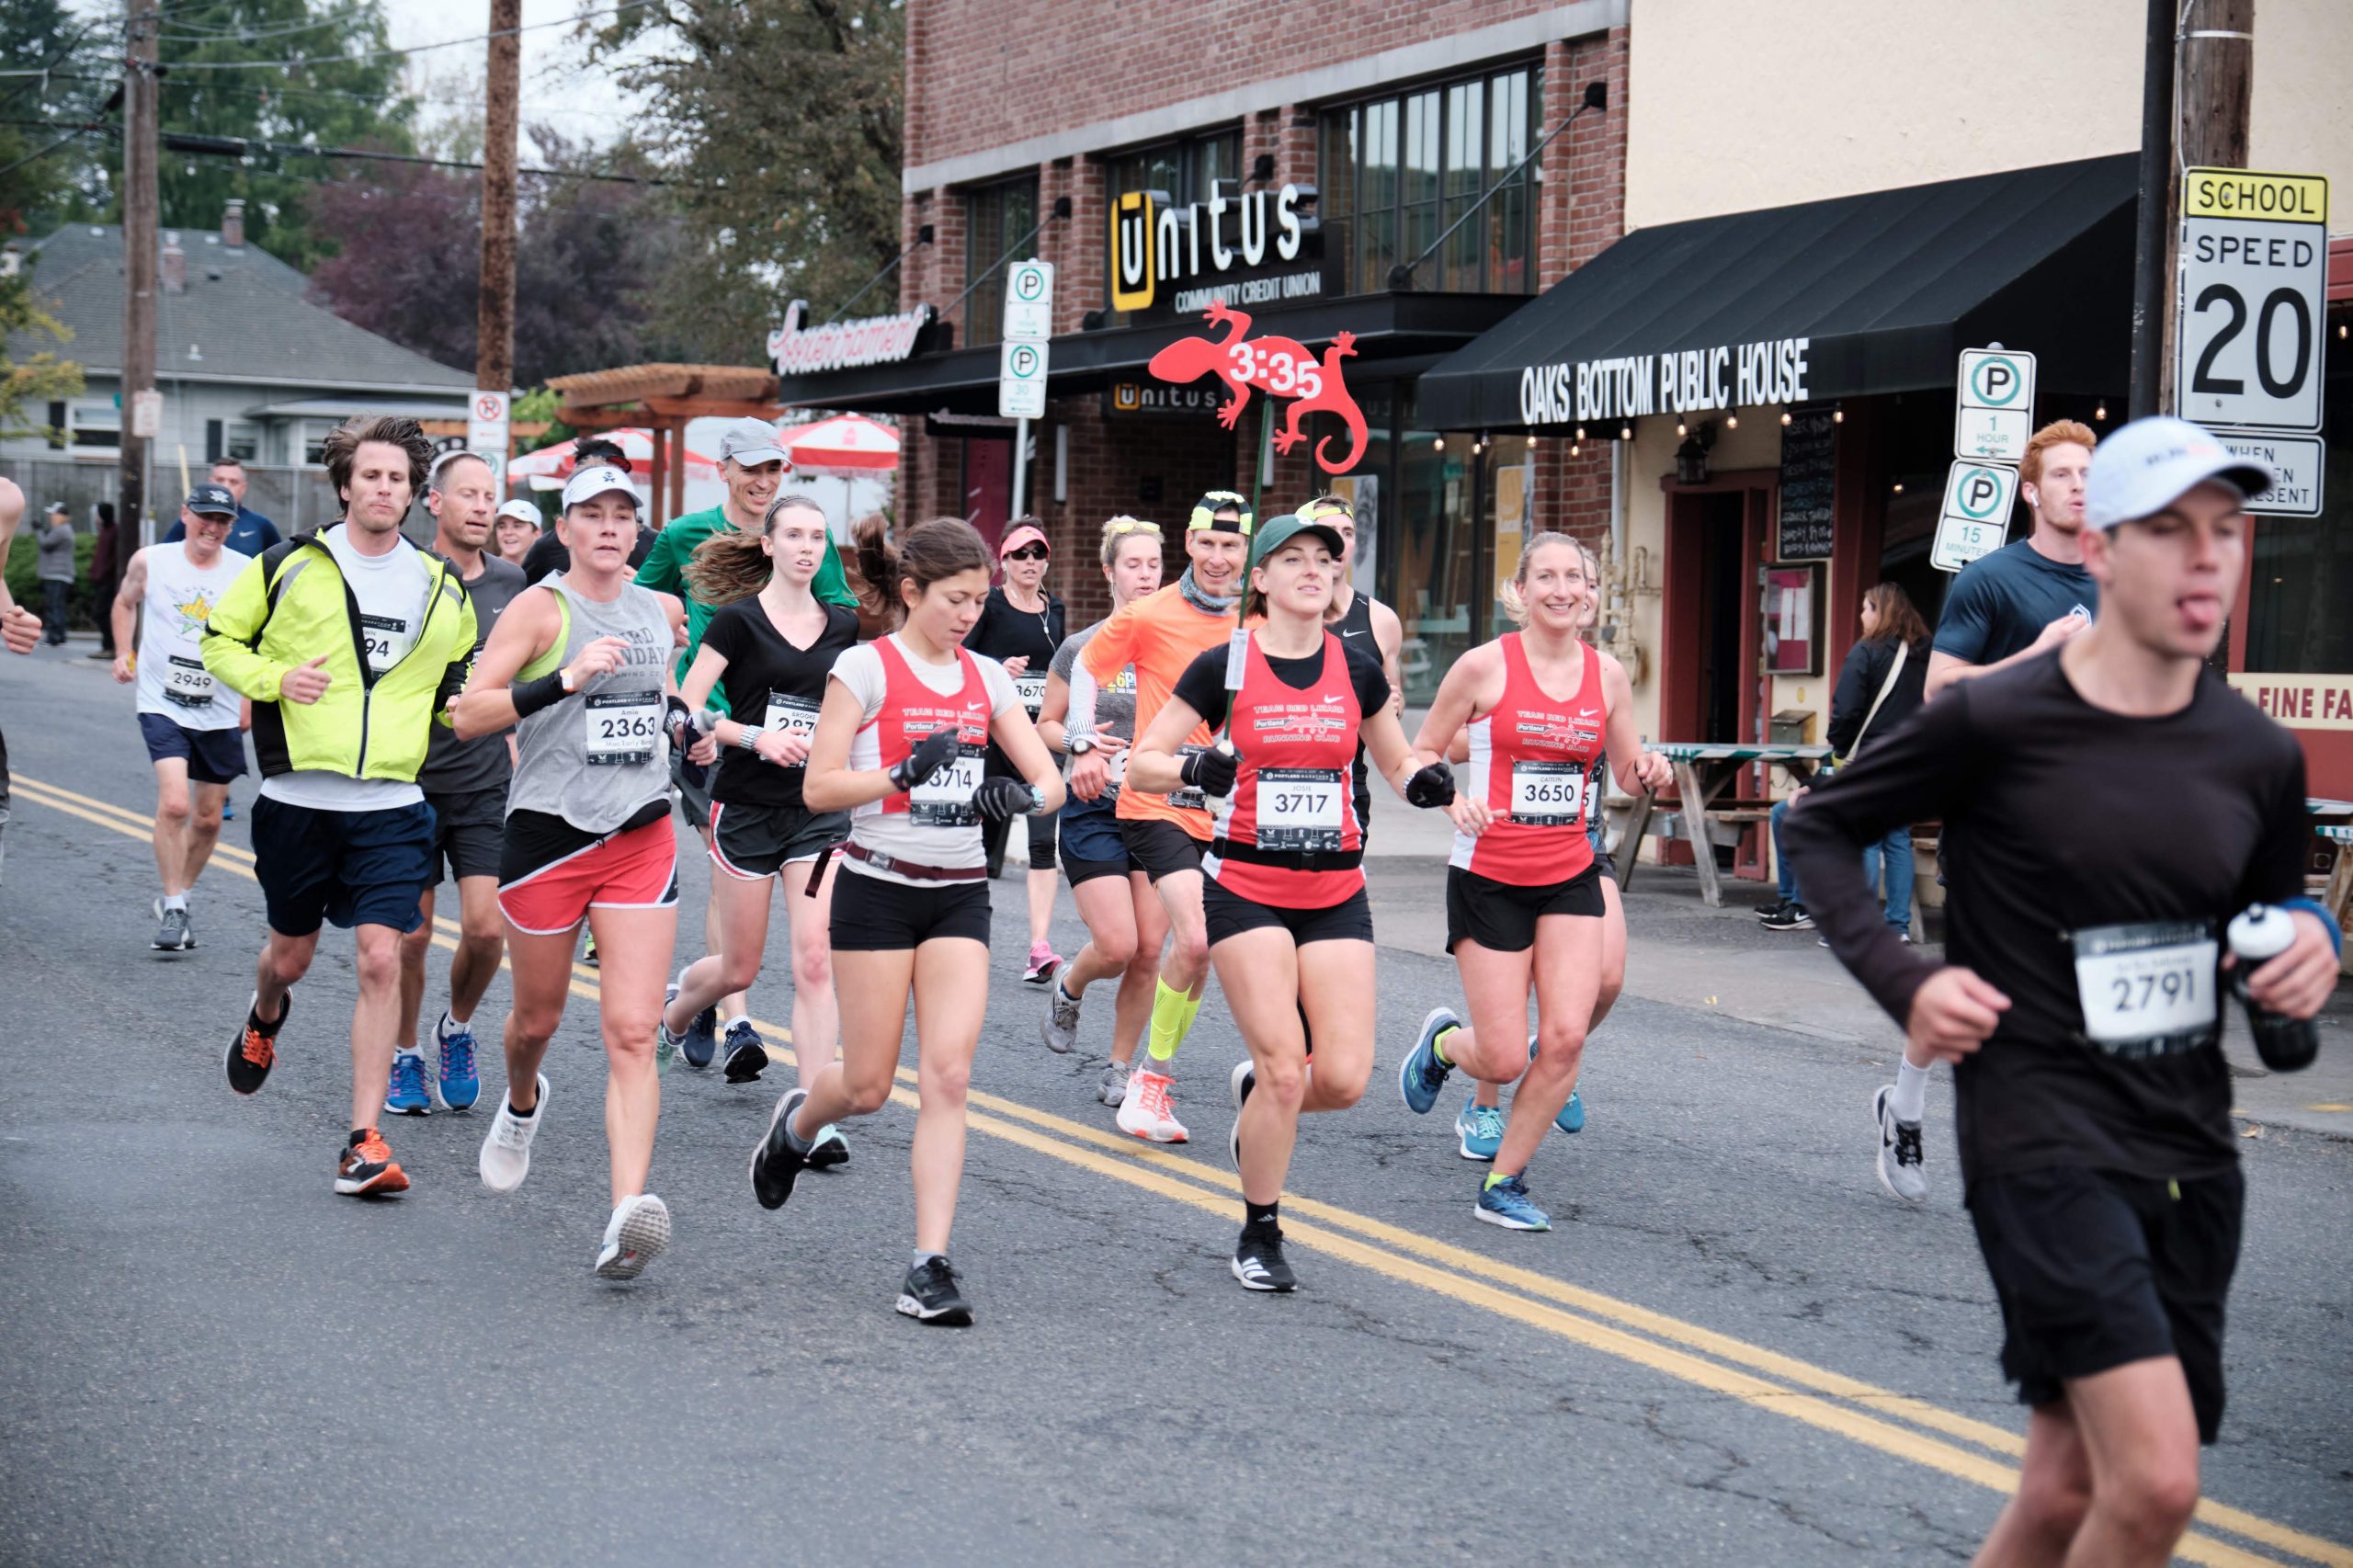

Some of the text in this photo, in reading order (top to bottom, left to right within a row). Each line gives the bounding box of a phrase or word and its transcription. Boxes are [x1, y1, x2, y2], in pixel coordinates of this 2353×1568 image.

[2198, 180, 2315, 214] SCHOOL
[2195, 234, 2313, 268] SPEED
[1024, 275, 1038, 294] P
[1175, 271, 1321, 313] COMMUNITY CREDIT UNION
[2191, 282, 2313, 400] 20
[1018, 351, 1032, 370] P
[1229, 343, 1323, 400] 3:35
[1520, 337, 1809, 426] OAKS BOTTOM PUBLIC HOUSE
[1986, 367, 2010, 396] P
[1989, 415, 1997, 432] 1
[1976, 433, 2009, 444] HOUR
[2225, 446, 2275, 462] WHEN
[1969, 479, 1994, 507] P
[2255, 484, 2310, 505] ESENT
[1961, 526, 1982, 543] 15
[620, 646, 665, 666] NDAY
[173, 672, 211, 688] 2949
[1253, 704, 1346, 714] TEAM RED LIZARD
[2257, 687, 2313, 719] FINE
[791, 711, 816, 721] BROOKE
[1256, 719, 1345, 727] Portland Oregon
[1517, 710, 1545, 720] TEAM
[600, 716, 655, 739] 2363
[905, 722, 934, 731] Portland
[1518, 723, 1545, 733] Portland
[1314, 734, 1341, 744] CLUB
[929, 769, 972, 789] 3714
[1524, 783, 1575, 802] 3650
[1274, 793, 1329, 813] 3717
[2111, 969, 2194, 1013] 2791
